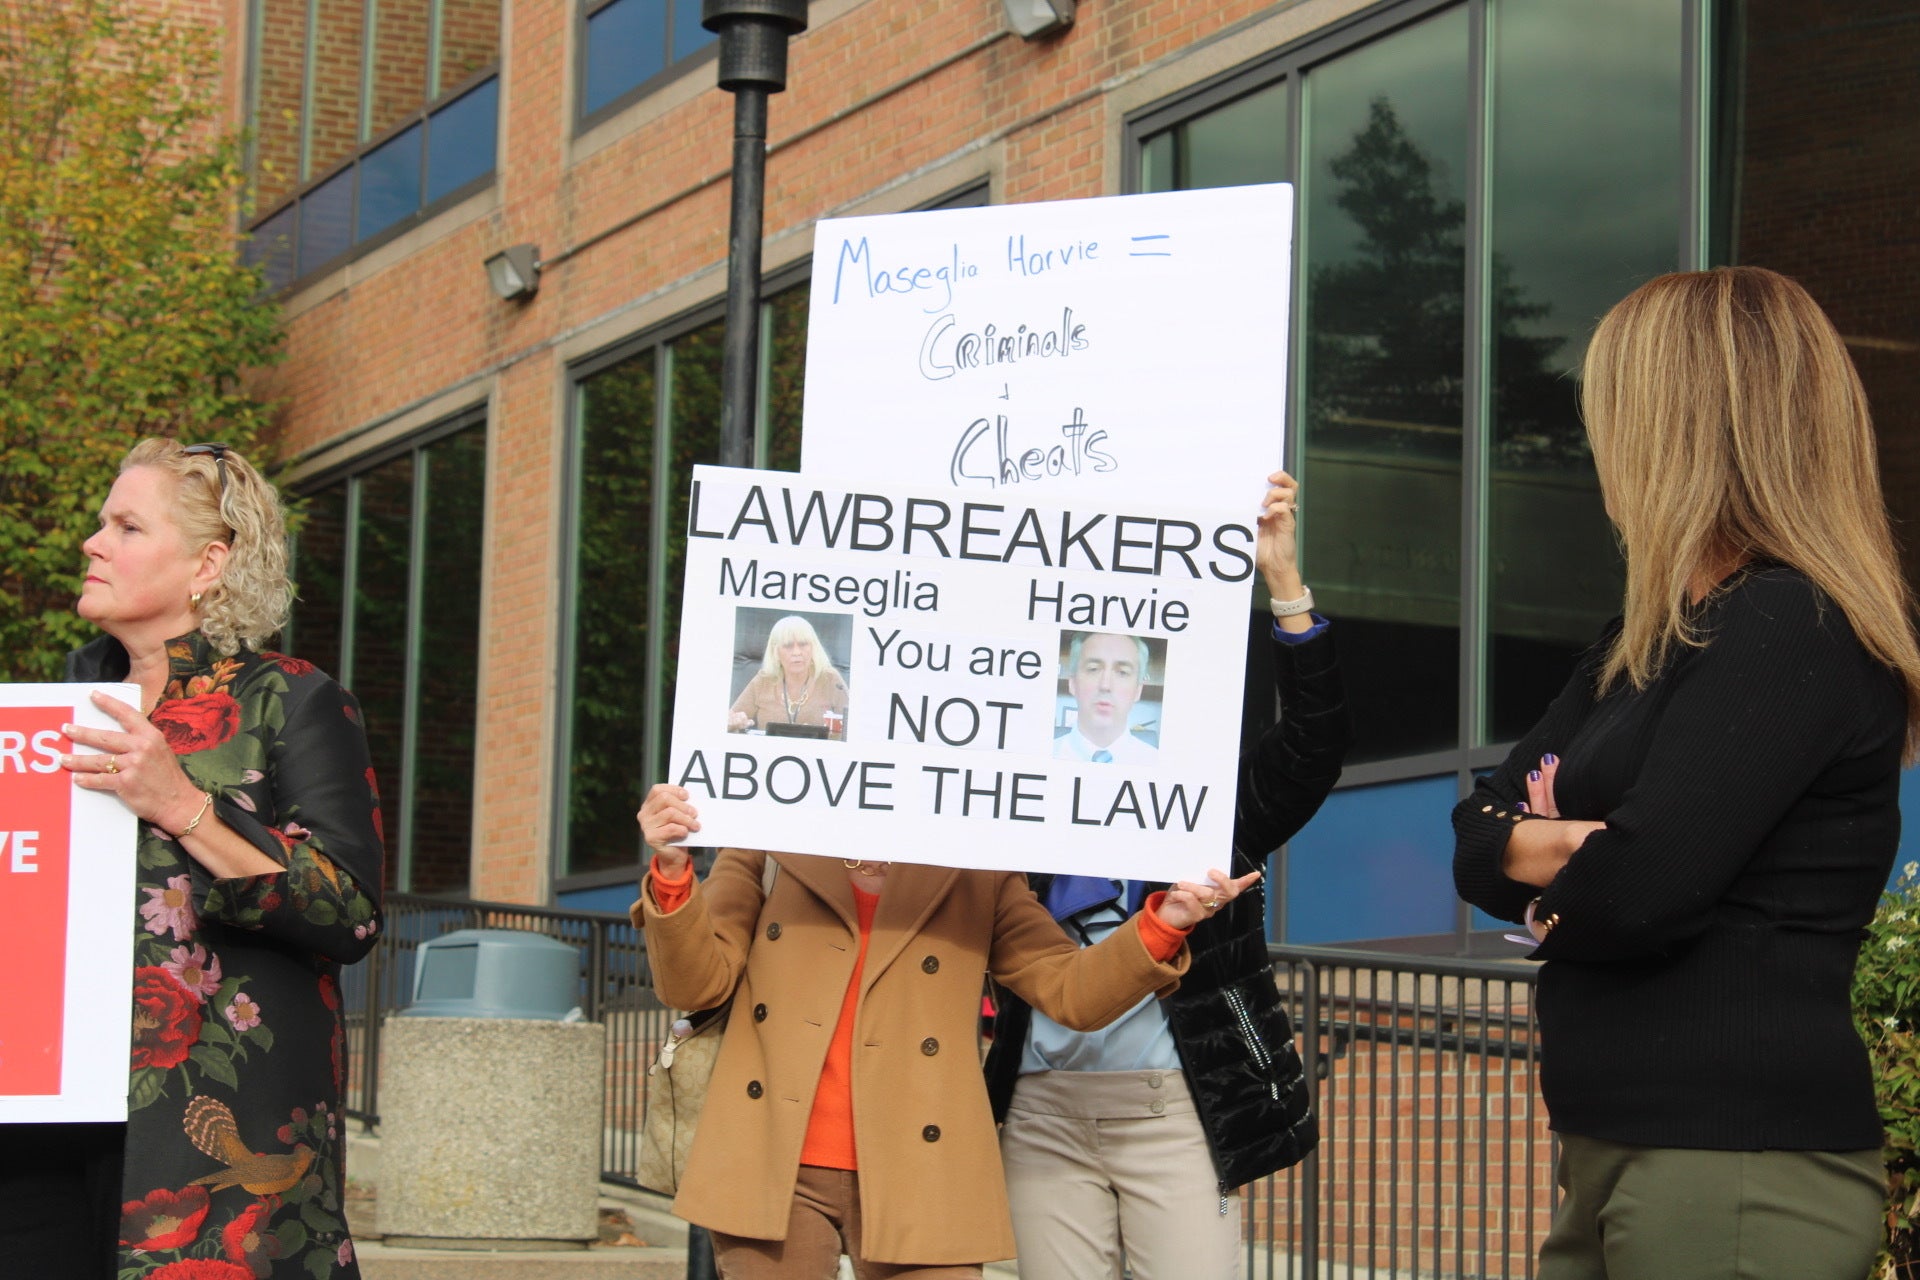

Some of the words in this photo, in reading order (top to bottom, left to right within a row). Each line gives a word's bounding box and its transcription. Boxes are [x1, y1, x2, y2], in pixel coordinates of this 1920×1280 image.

[833, 236, 978, 314] Maseglia
[1008, 234, 1098, 276] Harvie
[950, 407, 1119, 489] Cheats
[688, 480, 1255, 583] LAWBREAKERS
[719, 557, 940, 618] Marseglia
[1028, 579, 1190, 633] Harvie
[868, 627, 951, 673] You
[969, 646, 1042, 680] are
[887, 692, 1023, 750] NOT
[679, 750, 895, 811] ABOVE
[922, 766, 1047, 822] THE
[1071, 777, 1209, 833] LAW
